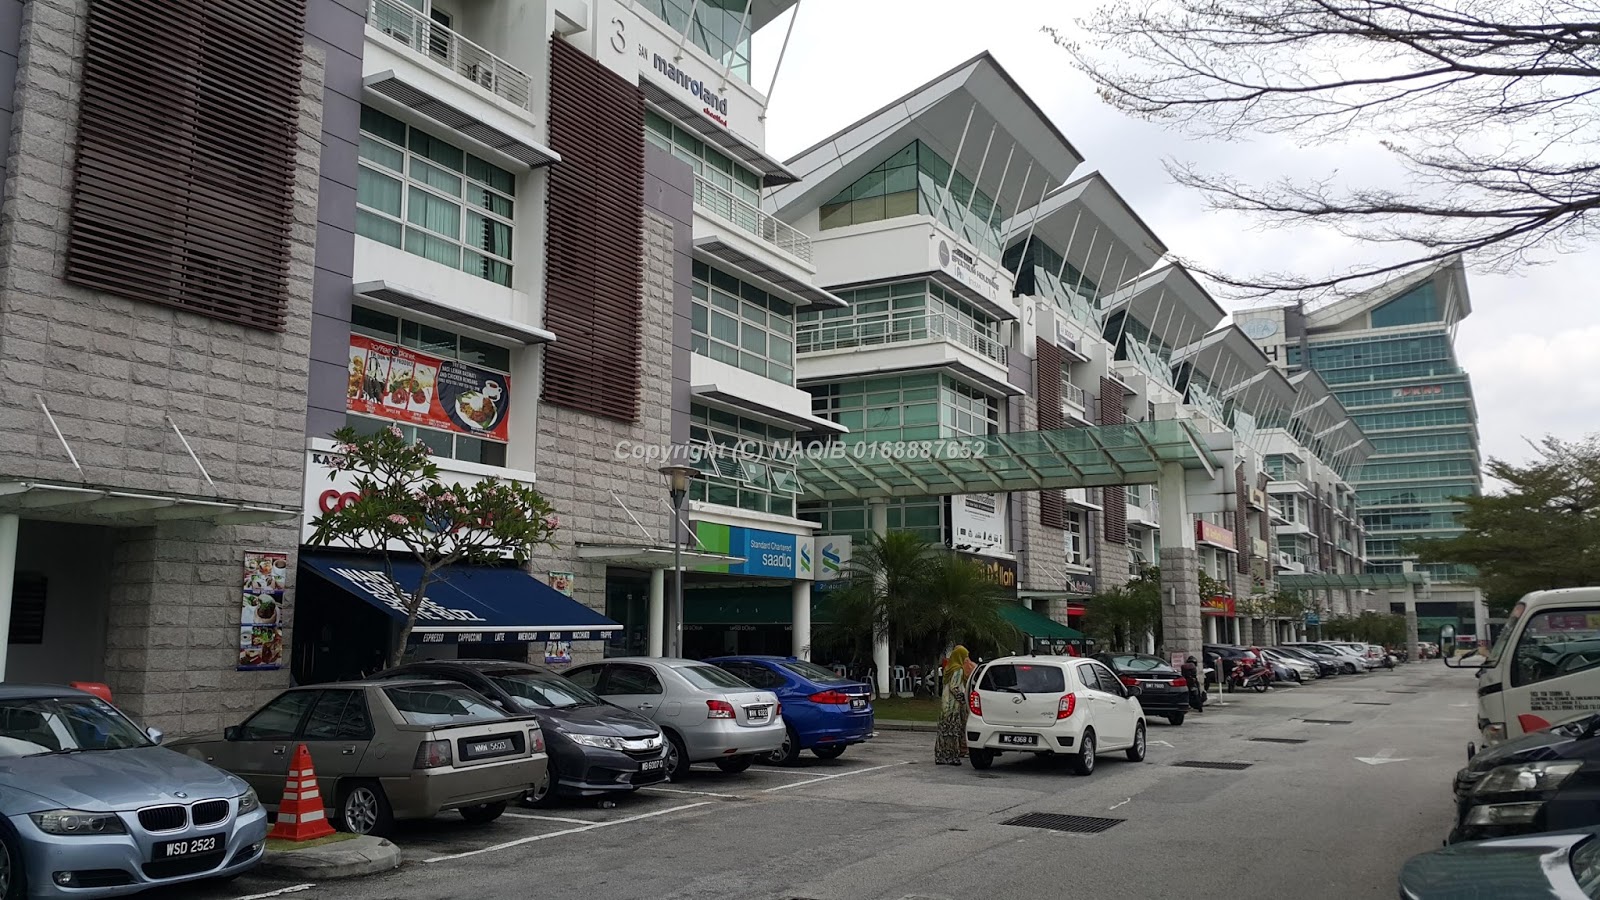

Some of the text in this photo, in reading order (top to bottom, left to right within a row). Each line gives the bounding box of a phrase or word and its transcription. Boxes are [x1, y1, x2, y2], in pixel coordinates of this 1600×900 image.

[610, 16, 626, 54] 3
[653, 53, 728, 116] manroland
[1026, 306, 1033, 326] 2
[750, 539, 792, 553] Standard Chartered
[762, 553, 792, 571] saadiq
[423, 633, 444, 642] ESPRESSO
[458, 633, 482, 642] CAPPUCCINO
[494, 632, 505, 641] LATTE
[518, 632, 538, 641] AMERICANO
[166, 837, 216, 856] WSD 2523
